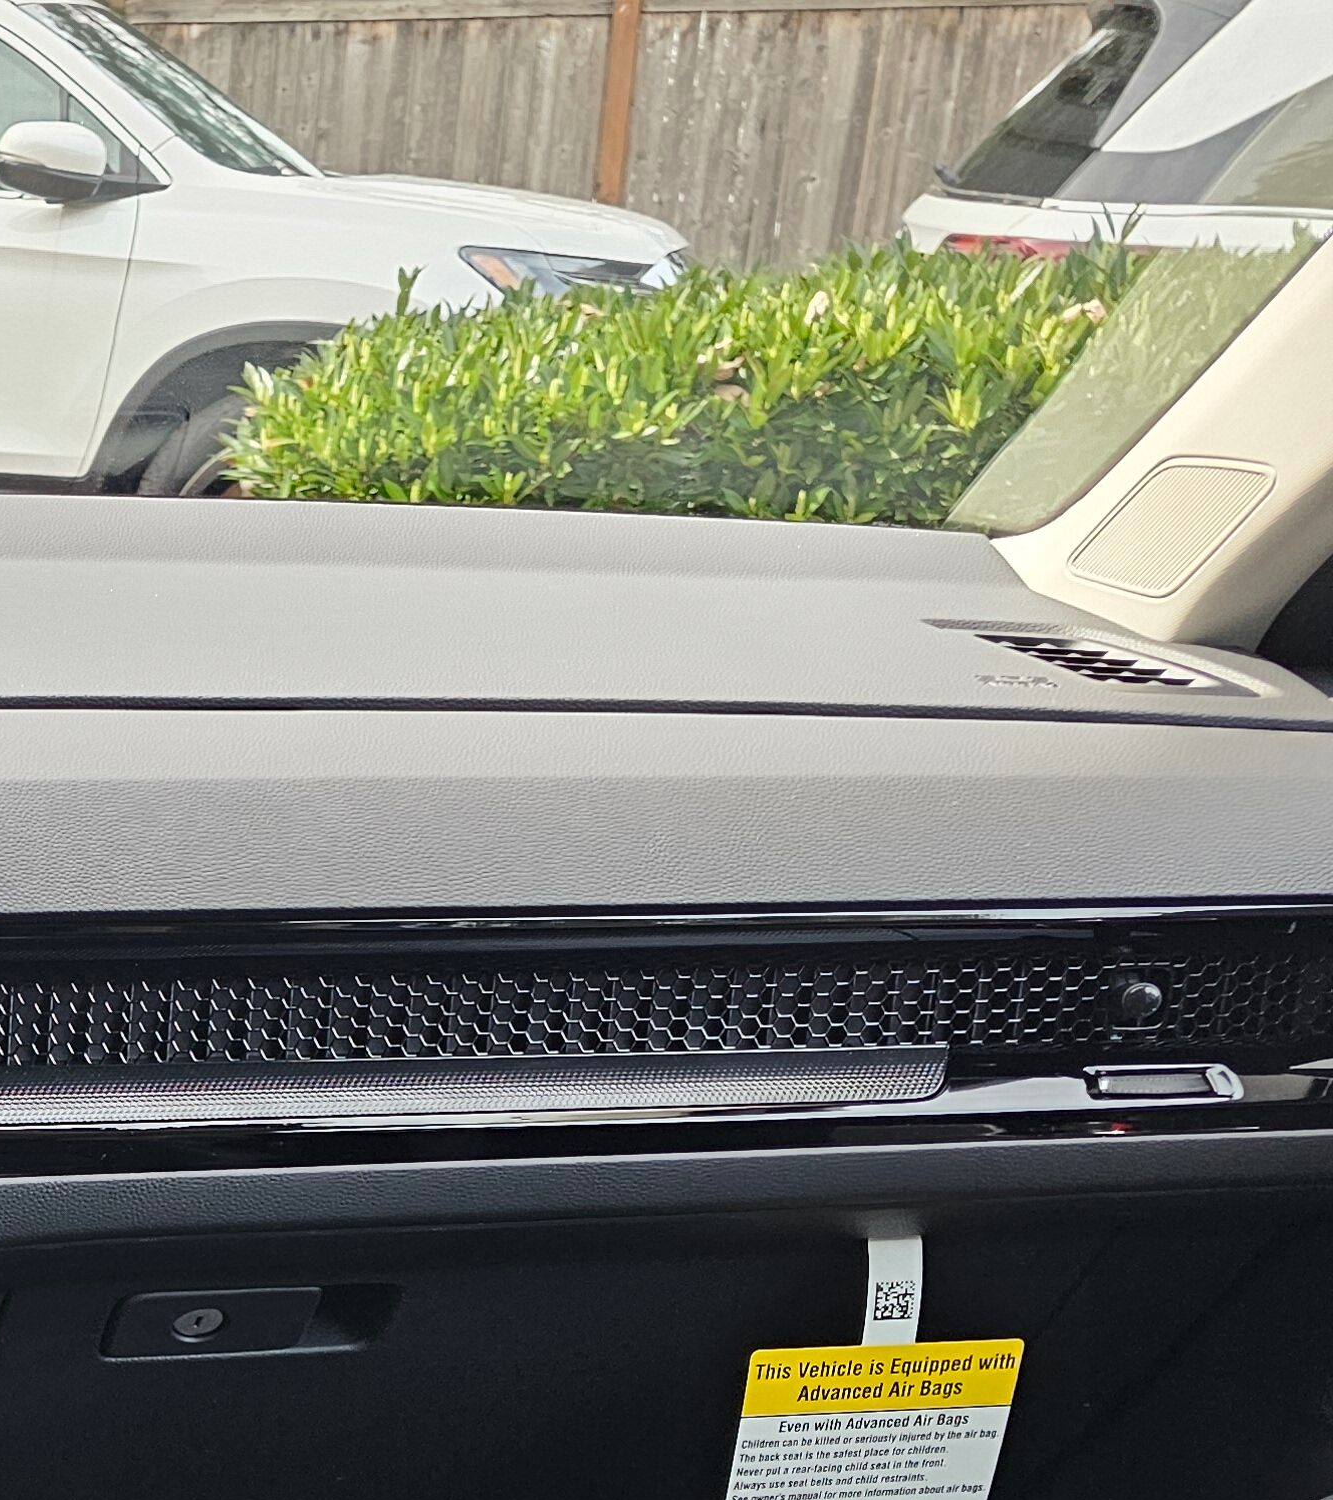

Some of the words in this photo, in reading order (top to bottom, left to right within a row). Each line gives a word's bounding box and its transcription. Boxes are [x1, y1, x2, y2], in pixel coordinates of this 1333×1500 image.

[756, 1363, 791, 1380] This
[799, 1360, 862, 1378] Vehicle
[869, 1359, 884, 1376] is
[890, 1355, 973, 1377] Equipped
[978, 1353, 1016, 1371] with
[797, 1383, 883, 1402] Advanced
[888, 1381, 914, 1398] Air
[920, 1380, 963, 1398] Bags
[779, 1420, 809, 1433] Even
[815, 1417, 841, 1431] with
[845, 1414, 909, 1430] Advanced
[914, 1413, 933, 1426] Air
[937, 1413, 969, 1427] Bags
[741, 1439, 780, 1449] Children
[782, 1439, 798, 1447] can
[801, 1437, 812, 1446] be
[814, 1436, 841, 1446] killed
[843, 1436, 851, 1444] or
[854, 1433, 896, 1445] seriously
[899, 1431, 931, 1443] injured
[934, 1431, 945, 1441] by
[947, 1430, 961, 1439] the
[964, 1430, 977, 1438] air
[979, 1429, 999, 1439] bag.
[740, 1454, 755, 1463] The
[759, 1452, 780, 1462] back
[783, 1451, 803, 1461] seat
[805, 1451, 813, 1460] is
[816, 1450, 830, 1460] the
[833, 1448, 862, 1459] safest
[864, 1448, 889, 1458] place
[892, 1447, 905, 1456] for
[907, 1446, 949, 1455] children.
[736, 1467, 764, 1477] Never
[765, 1466, 781, 1477] put
[792, 1463, 842, 1474] rear-facing
[844, 1461, 868, 1472] child
[870, 1461, 891, 1470] seat
[893, 1460, 901, 1469] in
[904, 1459, 919, 1469] the
[921, 1459, 946, 1468] front.
[733, 1481, 766, 1491] Always
[769, 1480, 785, 1488] use
[788, 1478, 808, 1487] seat
[810, 1477, 833, 1487] belts
[835, 1476, 853, 1485] and
[855, 1474, 878, 1484] child
[880, 1473, 928, 1483] restraints.
[787, 1491, 822, 1500] manual
[823, 1490, 836, 1499] for
[838, 1490, 862, 1498] more
[864, 1486, 916, 1497] information
[918, 1485, 945, 1495] about
[946, 1484, 960, 1493] air
[961, 1483, 986, 1493] bags.
